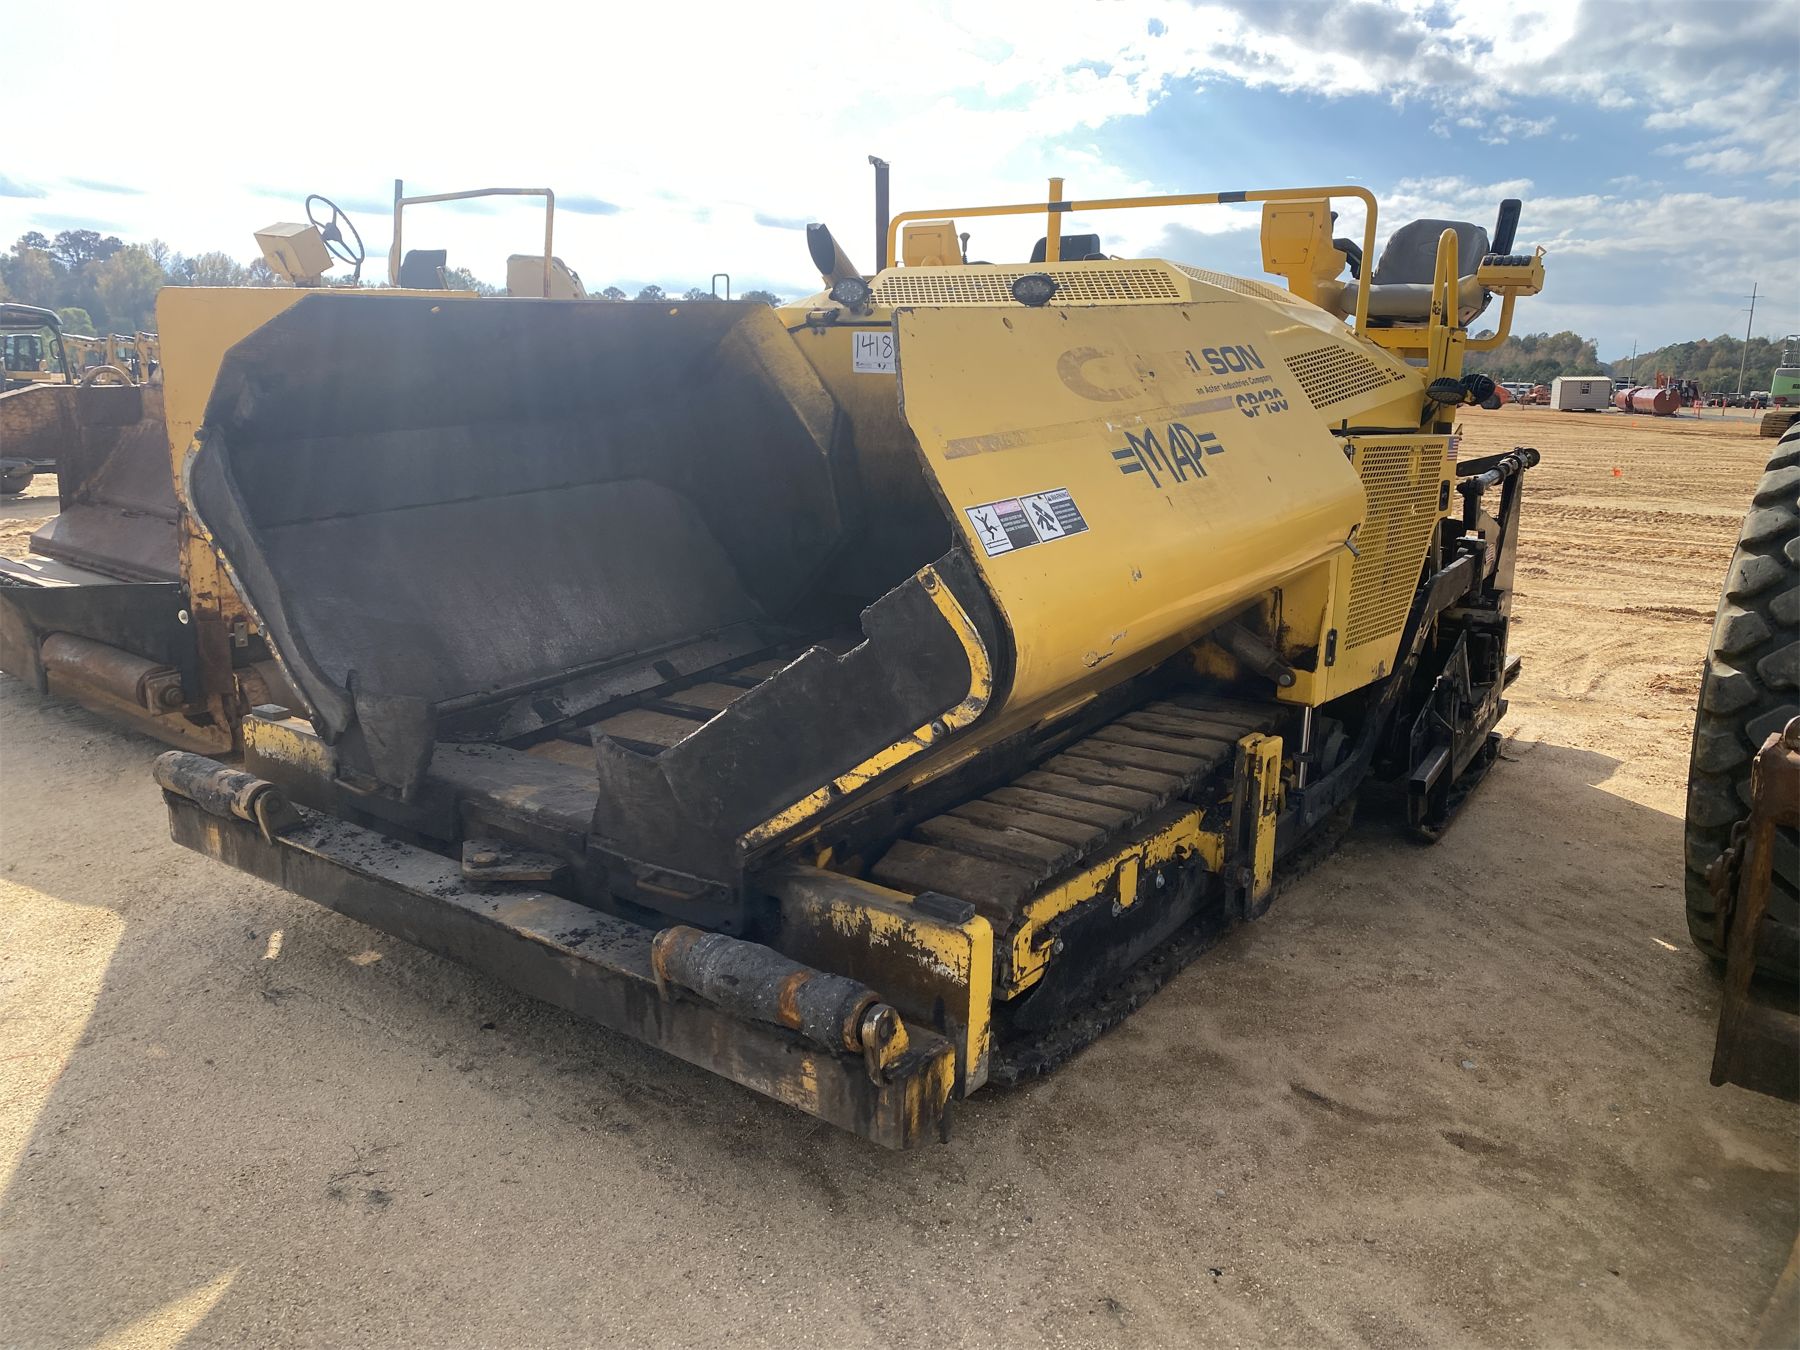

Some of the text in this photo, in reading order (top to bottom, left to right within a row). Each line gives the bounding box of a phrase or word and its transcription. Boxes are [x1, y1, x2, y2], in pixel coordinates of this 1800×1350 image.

[856, 333, 893, 359] 1418
[1235, 387, 1289, 418] CP130
[1124, 422, 1208, 489] MAP
